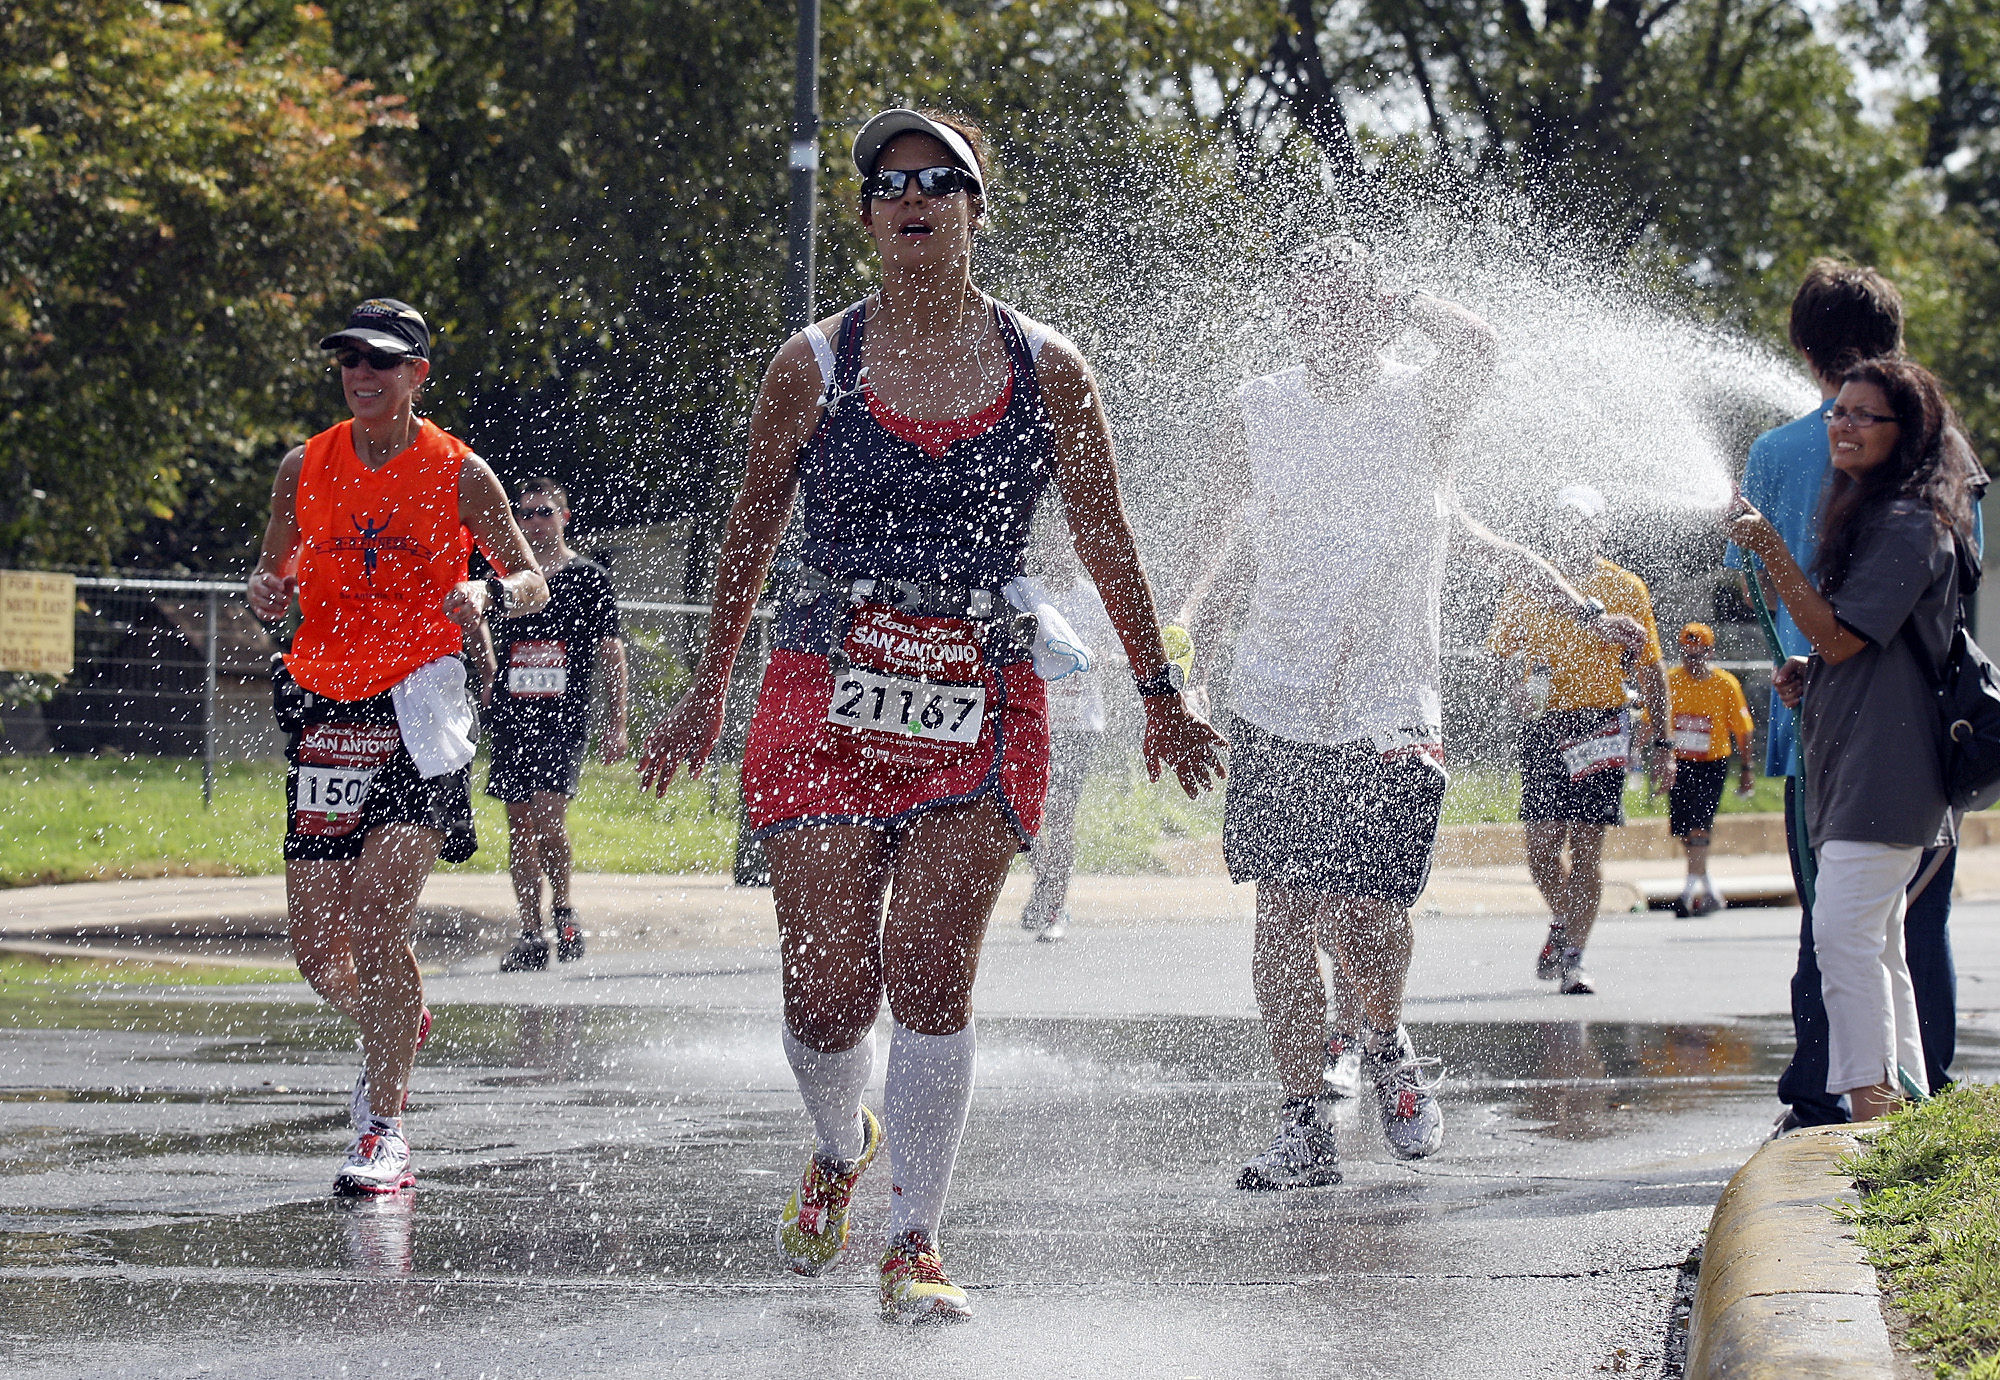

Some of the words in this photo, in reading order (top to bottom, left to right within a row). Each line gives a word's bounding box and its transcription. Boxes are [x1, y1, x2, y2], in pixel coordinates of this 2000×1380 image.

[361, 537, 408, 549] FITNESS
[852, 625, 895, 651] SAN
[894, 637, 978, 664] ANTONIO
[882, 653, 946, 673] marathon
[835, 680, 979, 733] 21167
[305, 734, 338, 752] SAN
